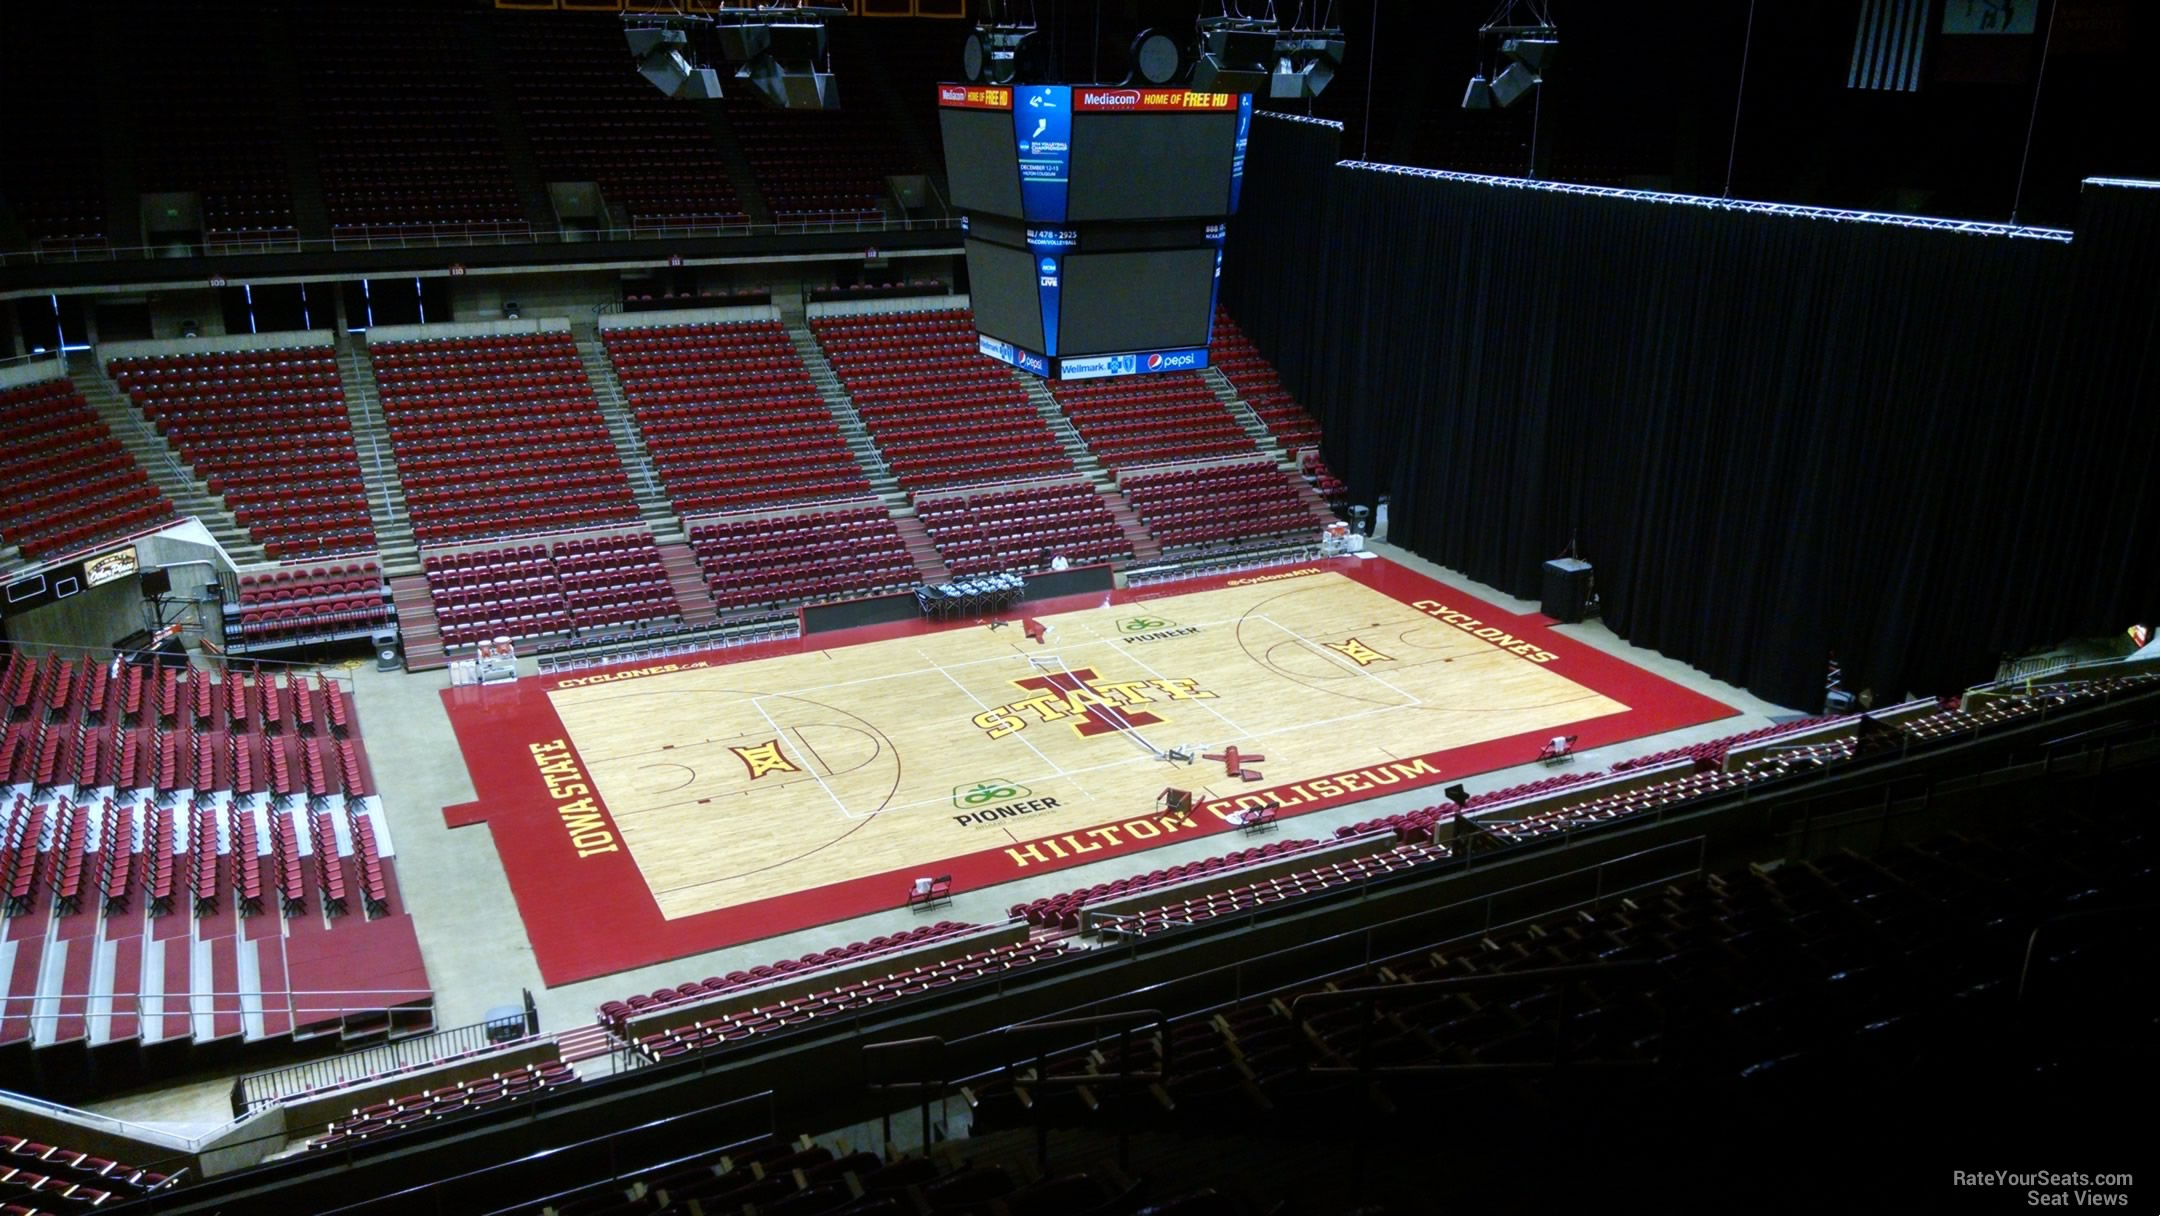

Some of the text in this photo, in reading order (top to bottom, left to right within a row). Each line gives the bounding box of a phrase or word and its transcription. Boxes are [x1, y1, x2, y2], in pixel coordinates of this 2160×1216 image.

[1084, 91, 1228, 107] Mediacom HOME OF FREE HD
[1039, 231, 1053, 239] 478
[1058, 231, 1077, 239] 2925
[1041, 279, 1058, 287] LIVE
[1026, 357, 1043, 370] pepsi
[1164, 352, 1195, 367] pepsi
[1061, 364, 1106, 375] Wellmark
[1123, 626, 1201, 644] PIONEER
[1411, 599, 1560, 664] CYCLONES
[972, 677, 1221, 740] STATE
[528, 739, 619, 859] IOWA STATE
[952, 796, 1062, 827] PIONEER
[1003, 811, 1198, 868] HILTON
